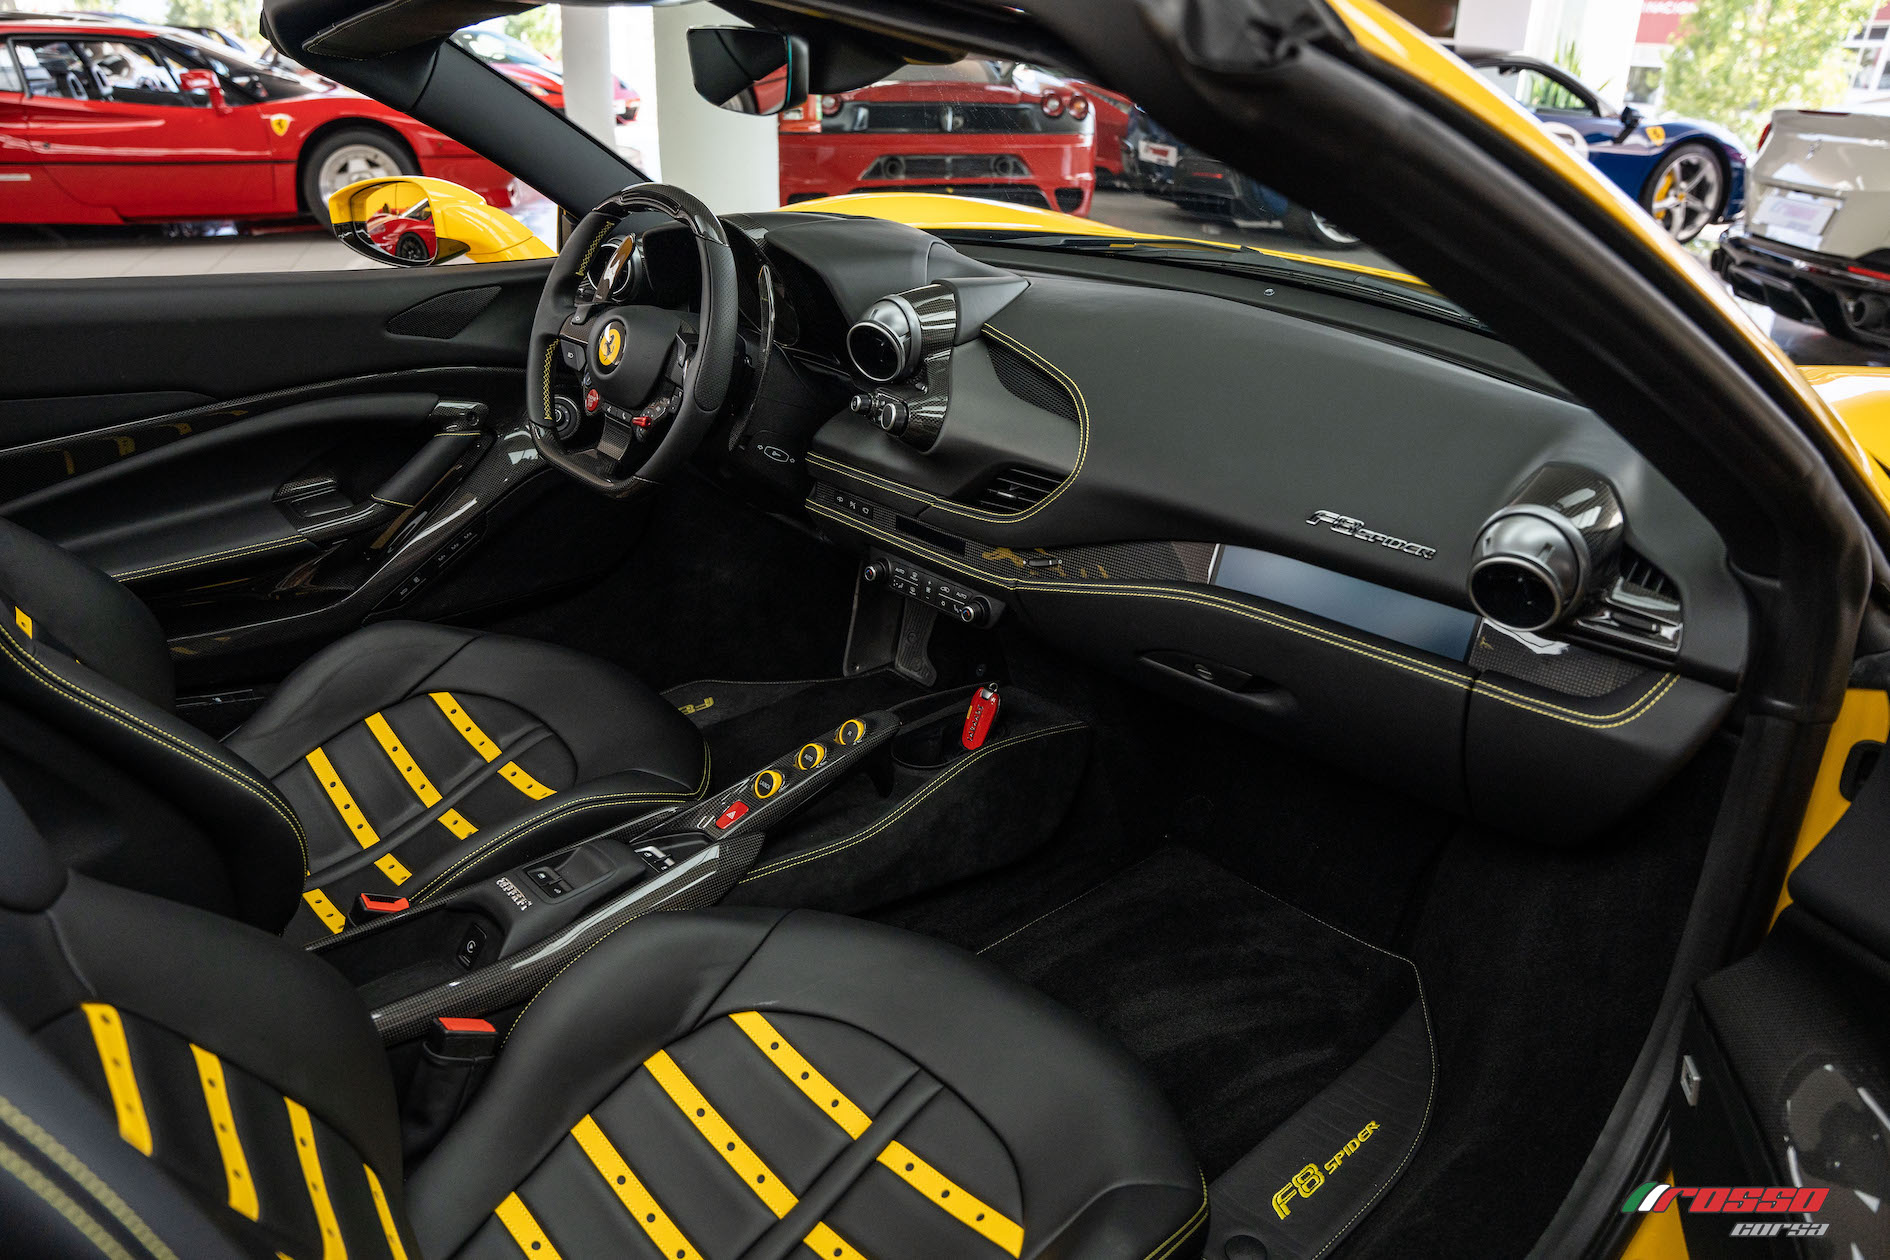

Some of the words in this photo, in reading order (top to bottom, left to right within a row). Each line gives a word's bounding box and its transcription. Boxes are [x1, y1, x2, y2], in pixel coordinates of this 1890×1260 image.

[1305, 509, 1365, 536] F8
[1354, 528, 1437, 559] SPIDER
[1271, 1162, 1326, 1221] F8
[1323, 1120, 1381, 1176] SPIDER
